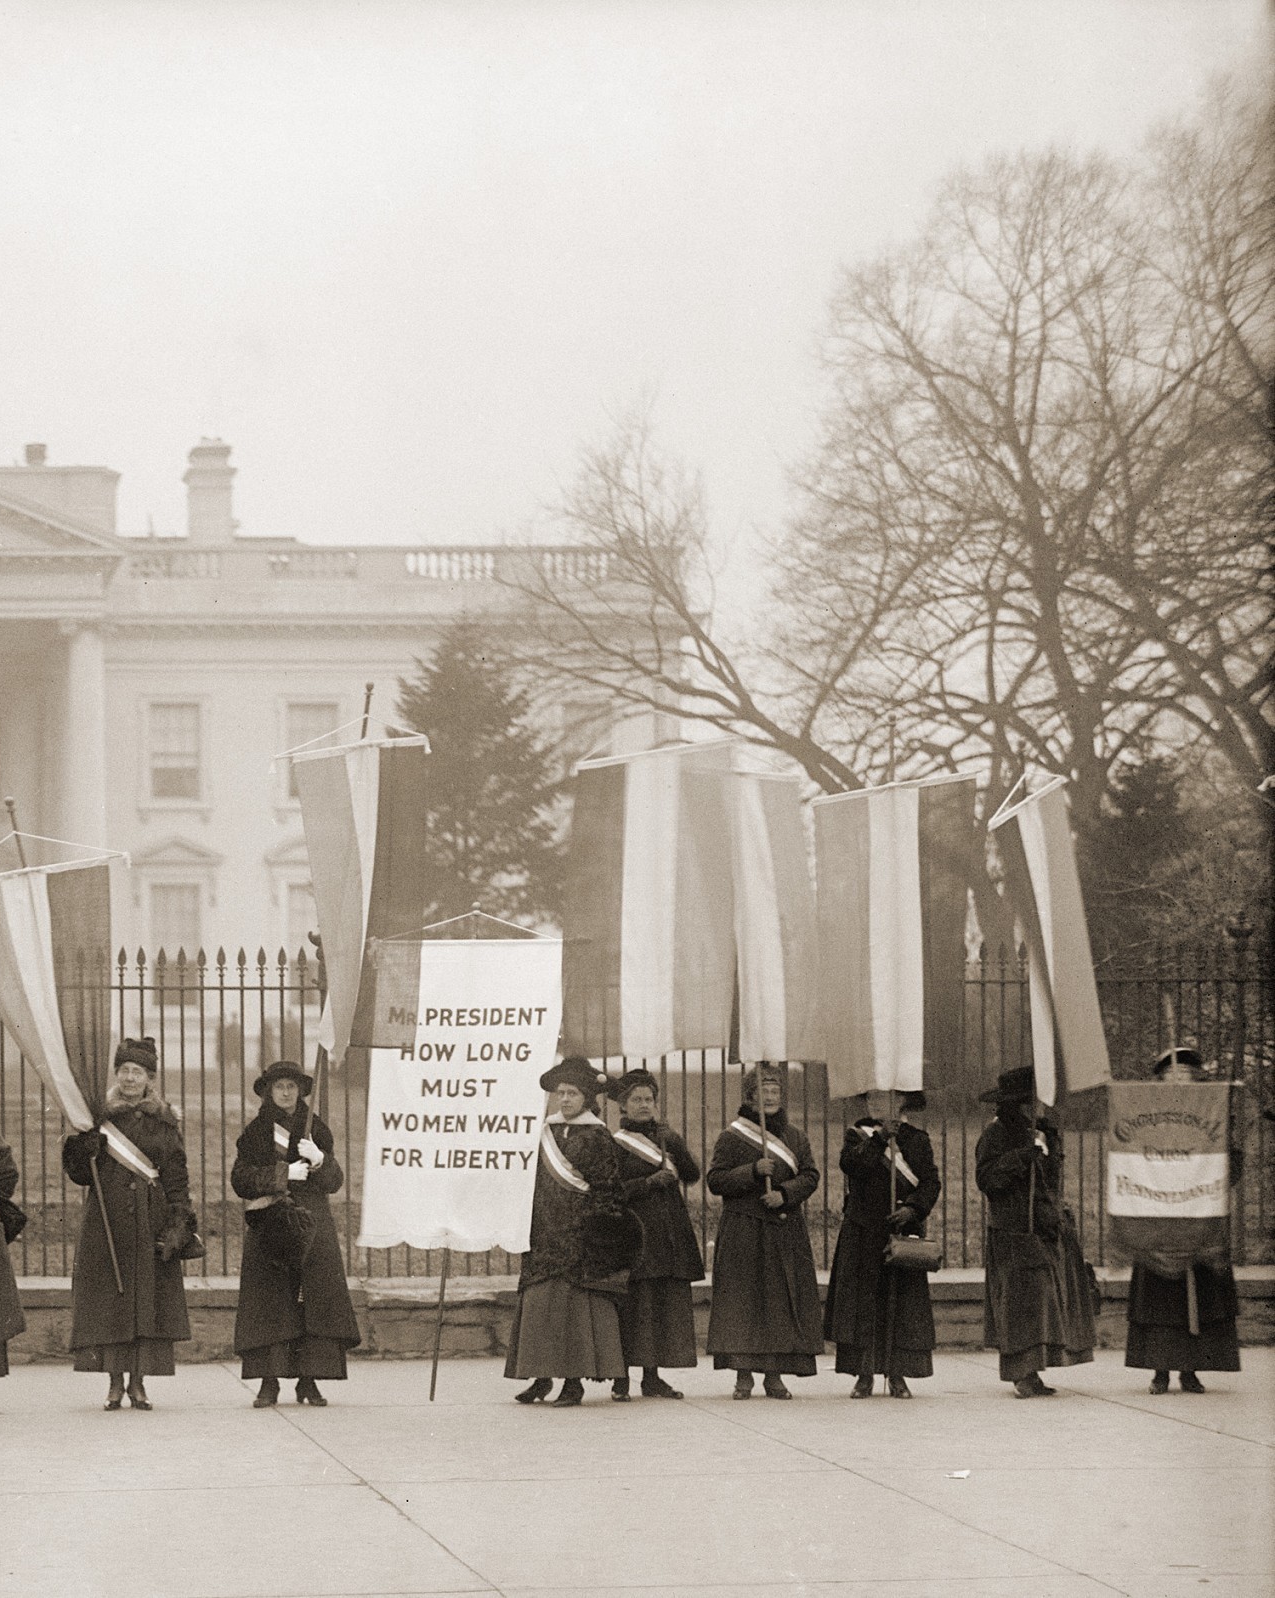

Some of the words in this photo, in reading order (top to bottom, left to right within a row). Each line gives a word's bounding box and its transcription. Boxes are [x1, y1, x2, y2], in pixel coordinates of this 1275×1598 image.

[425, 1007, 547, 1027] PRESIDENT
[400, 1042, 456, 1062] HOW
[466, 1042, 532, 1062] LONG
[421, 1078, 498, 1098] MUST
[381, 1112, 467, 1133] WOMEN
[478, 1114, 537, 1134] WAIT
[381, 1147, 424, 1168] FOR
[434, 1149, 534, 1171] LIBERTY
